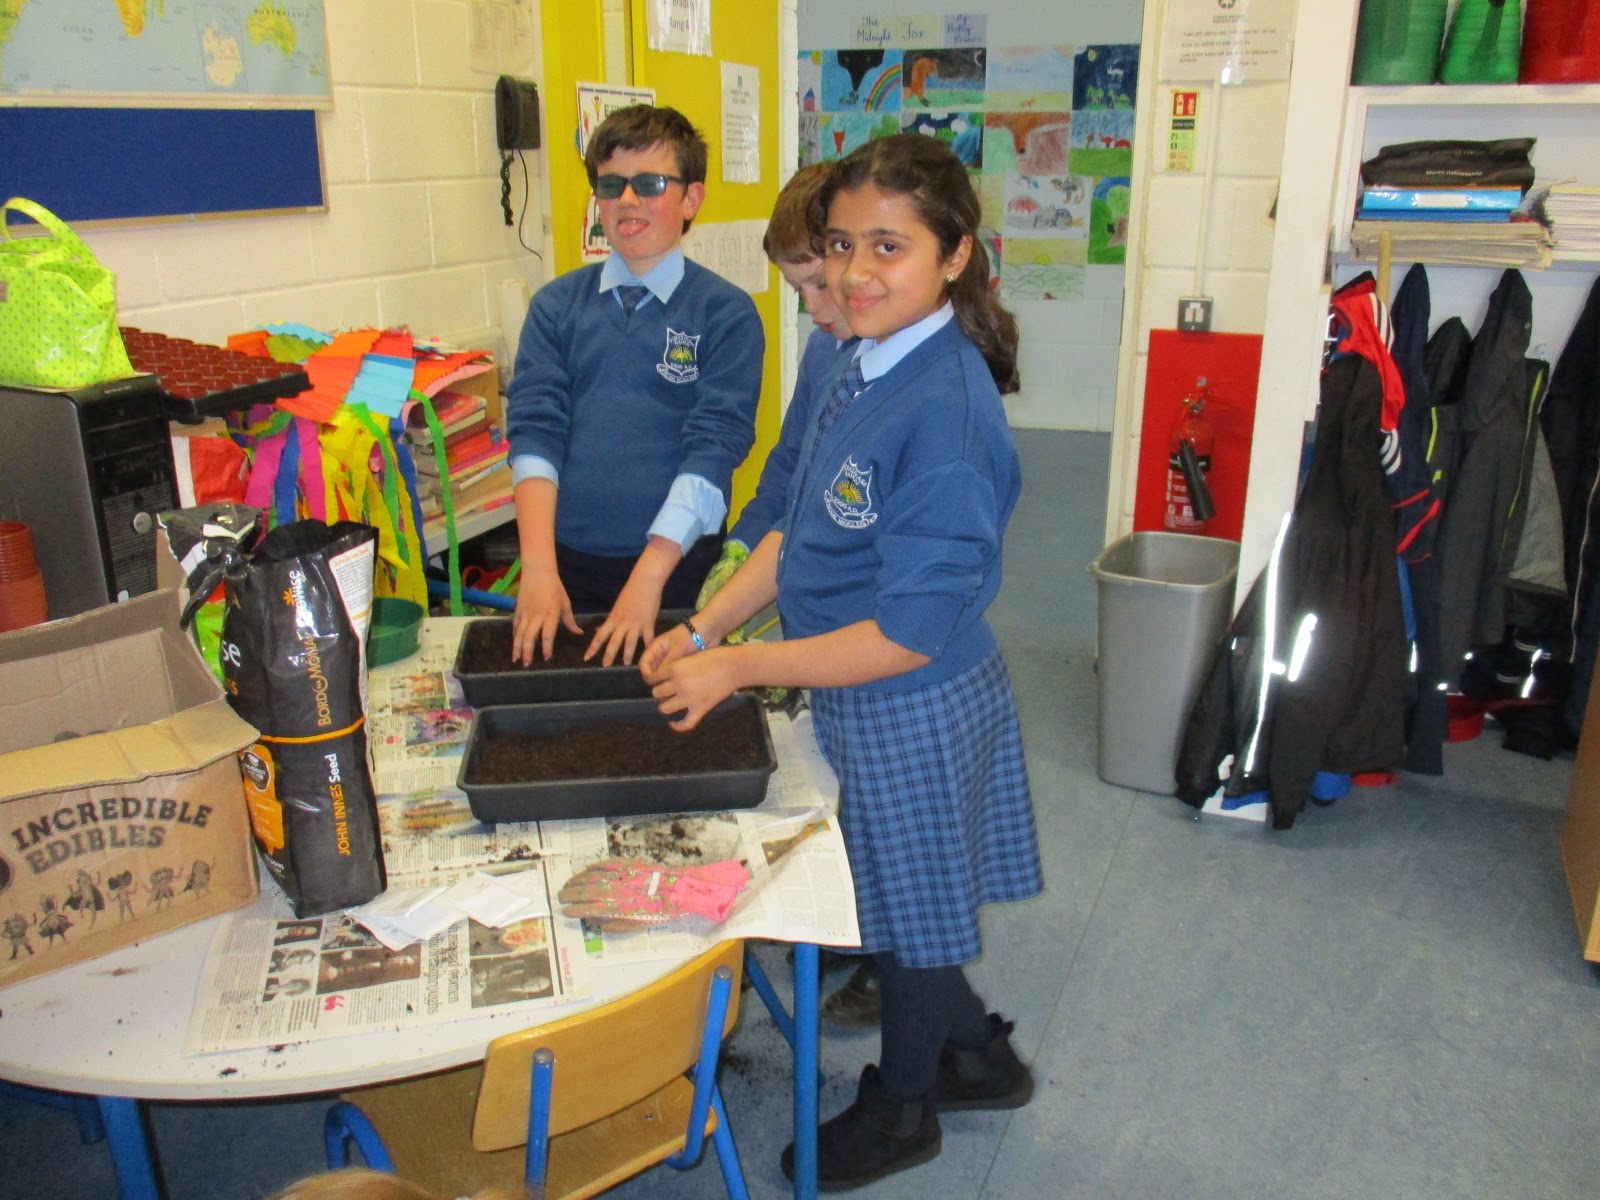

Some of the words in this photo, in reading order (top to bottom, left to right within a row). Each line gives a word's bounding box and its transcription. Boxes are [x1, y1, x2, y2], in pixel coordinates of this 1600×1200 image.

[856, 28, 892, 46] Midnight
[862, 16, 878, 26] The
[317, 693, 332, 727] BORD
[325, 753, 341, 783] Seed
[330, 784, 346, 818] INNES
[11, 797, 213, 851] INCREDIBLE
[336, 820, 350, 855] JOHN
[25, 825, 166, 875] EDIBLES
[426, 951, 441, 1014] breakthroughs
